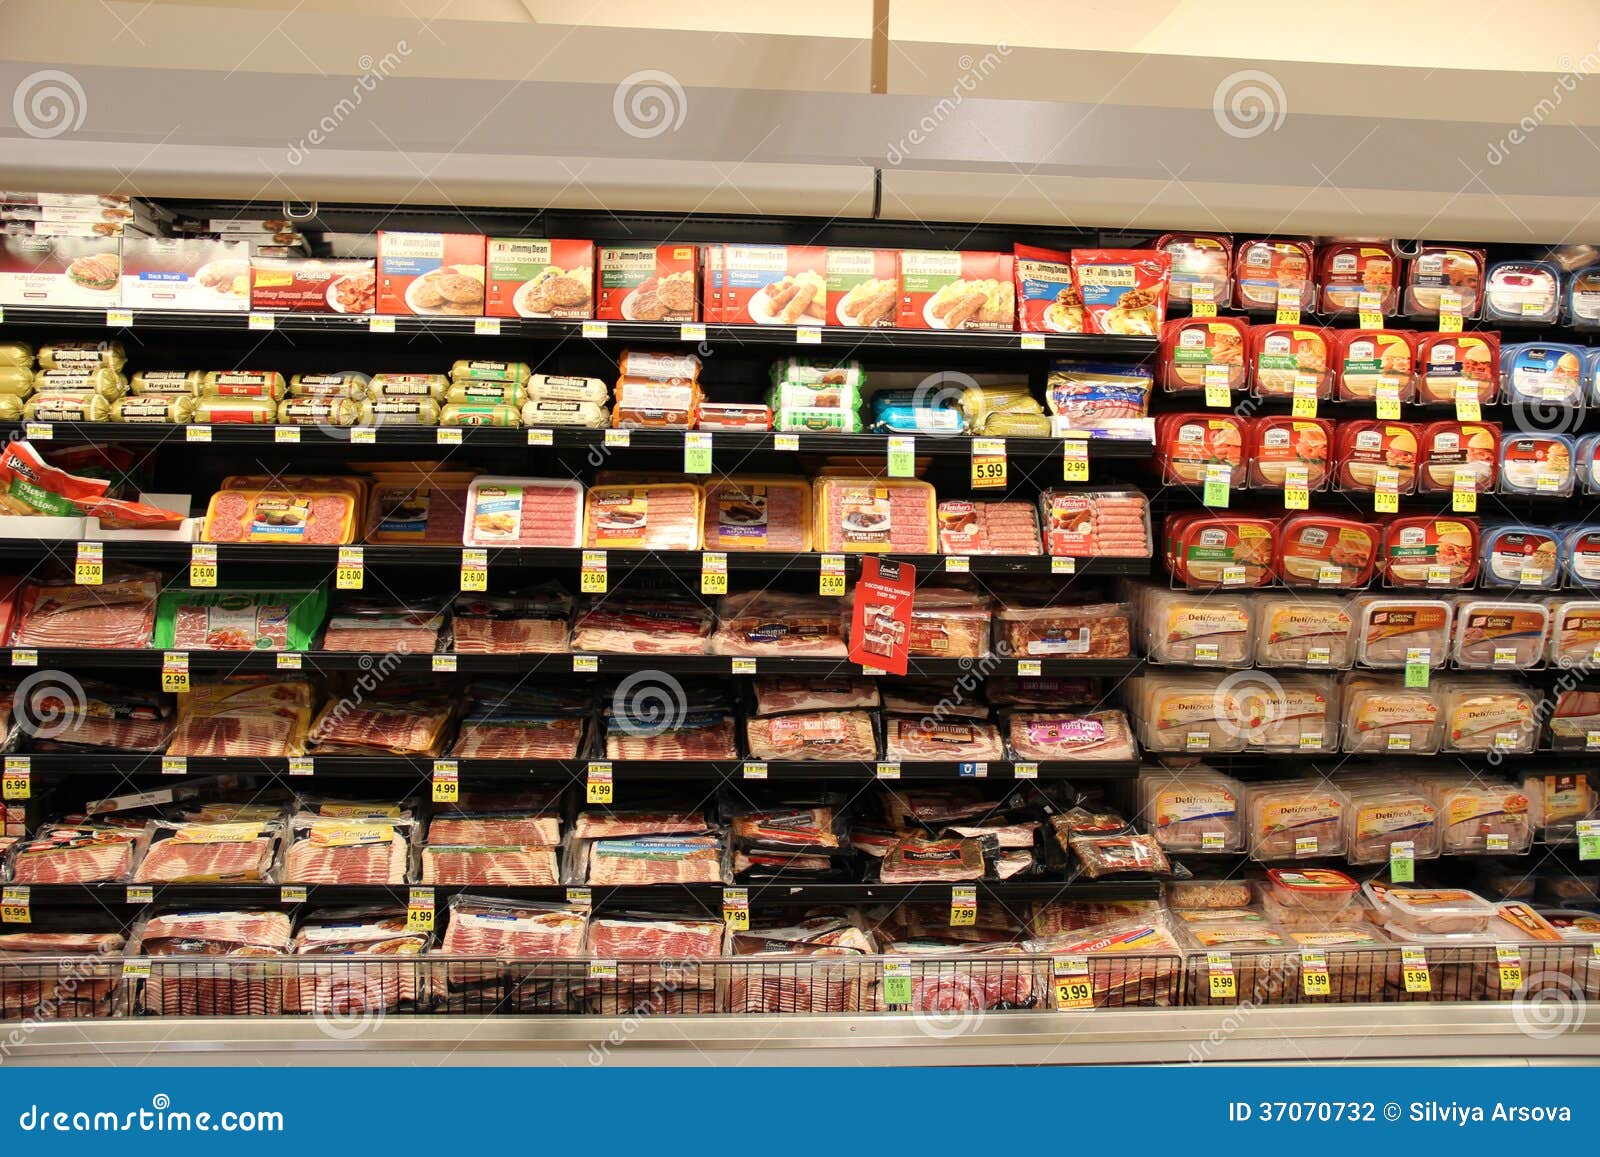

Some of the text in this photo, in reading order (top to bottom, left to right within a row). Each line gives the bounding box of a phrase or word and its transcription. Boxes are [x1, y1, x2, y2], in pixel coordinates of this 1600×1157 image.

[386, 259, 414, 267] Original
[61, 362, 96, 370] Regular
[219, 375, 262, 385] Jimmy Dean
[977, 463, 1003, 478] 5.99
[1067, 462, 1085, 472] 2.99
[19, 483, 47, 498] Diced
[18, 491, 59, 512] Potatoes
[165, 675, 186, 685] 2.99
[950, 727, 968, 735] FLAVOR
[6, 780, 27, 790] 6.99
[435, 784, 456, 794] 4.99
[590, 785, 610, 795] 4.99
[344, 830, 381, 839] Center Cut
[4, 907, 26, 917] 6.99
[410, 911, 432, 922] 4.99
[726, 911, 746, 921] 7.99
[953, 910, 974, 920] 7.99
[1307, 975, 1327, 985] 5.99
[1407, 973, 1427, 982] 5.99
[1503, 970, 1520, 980] 5.99
[1213, 977, 1233, 988] 5.99
[1060, 985, 1088, 1000] 3.99
